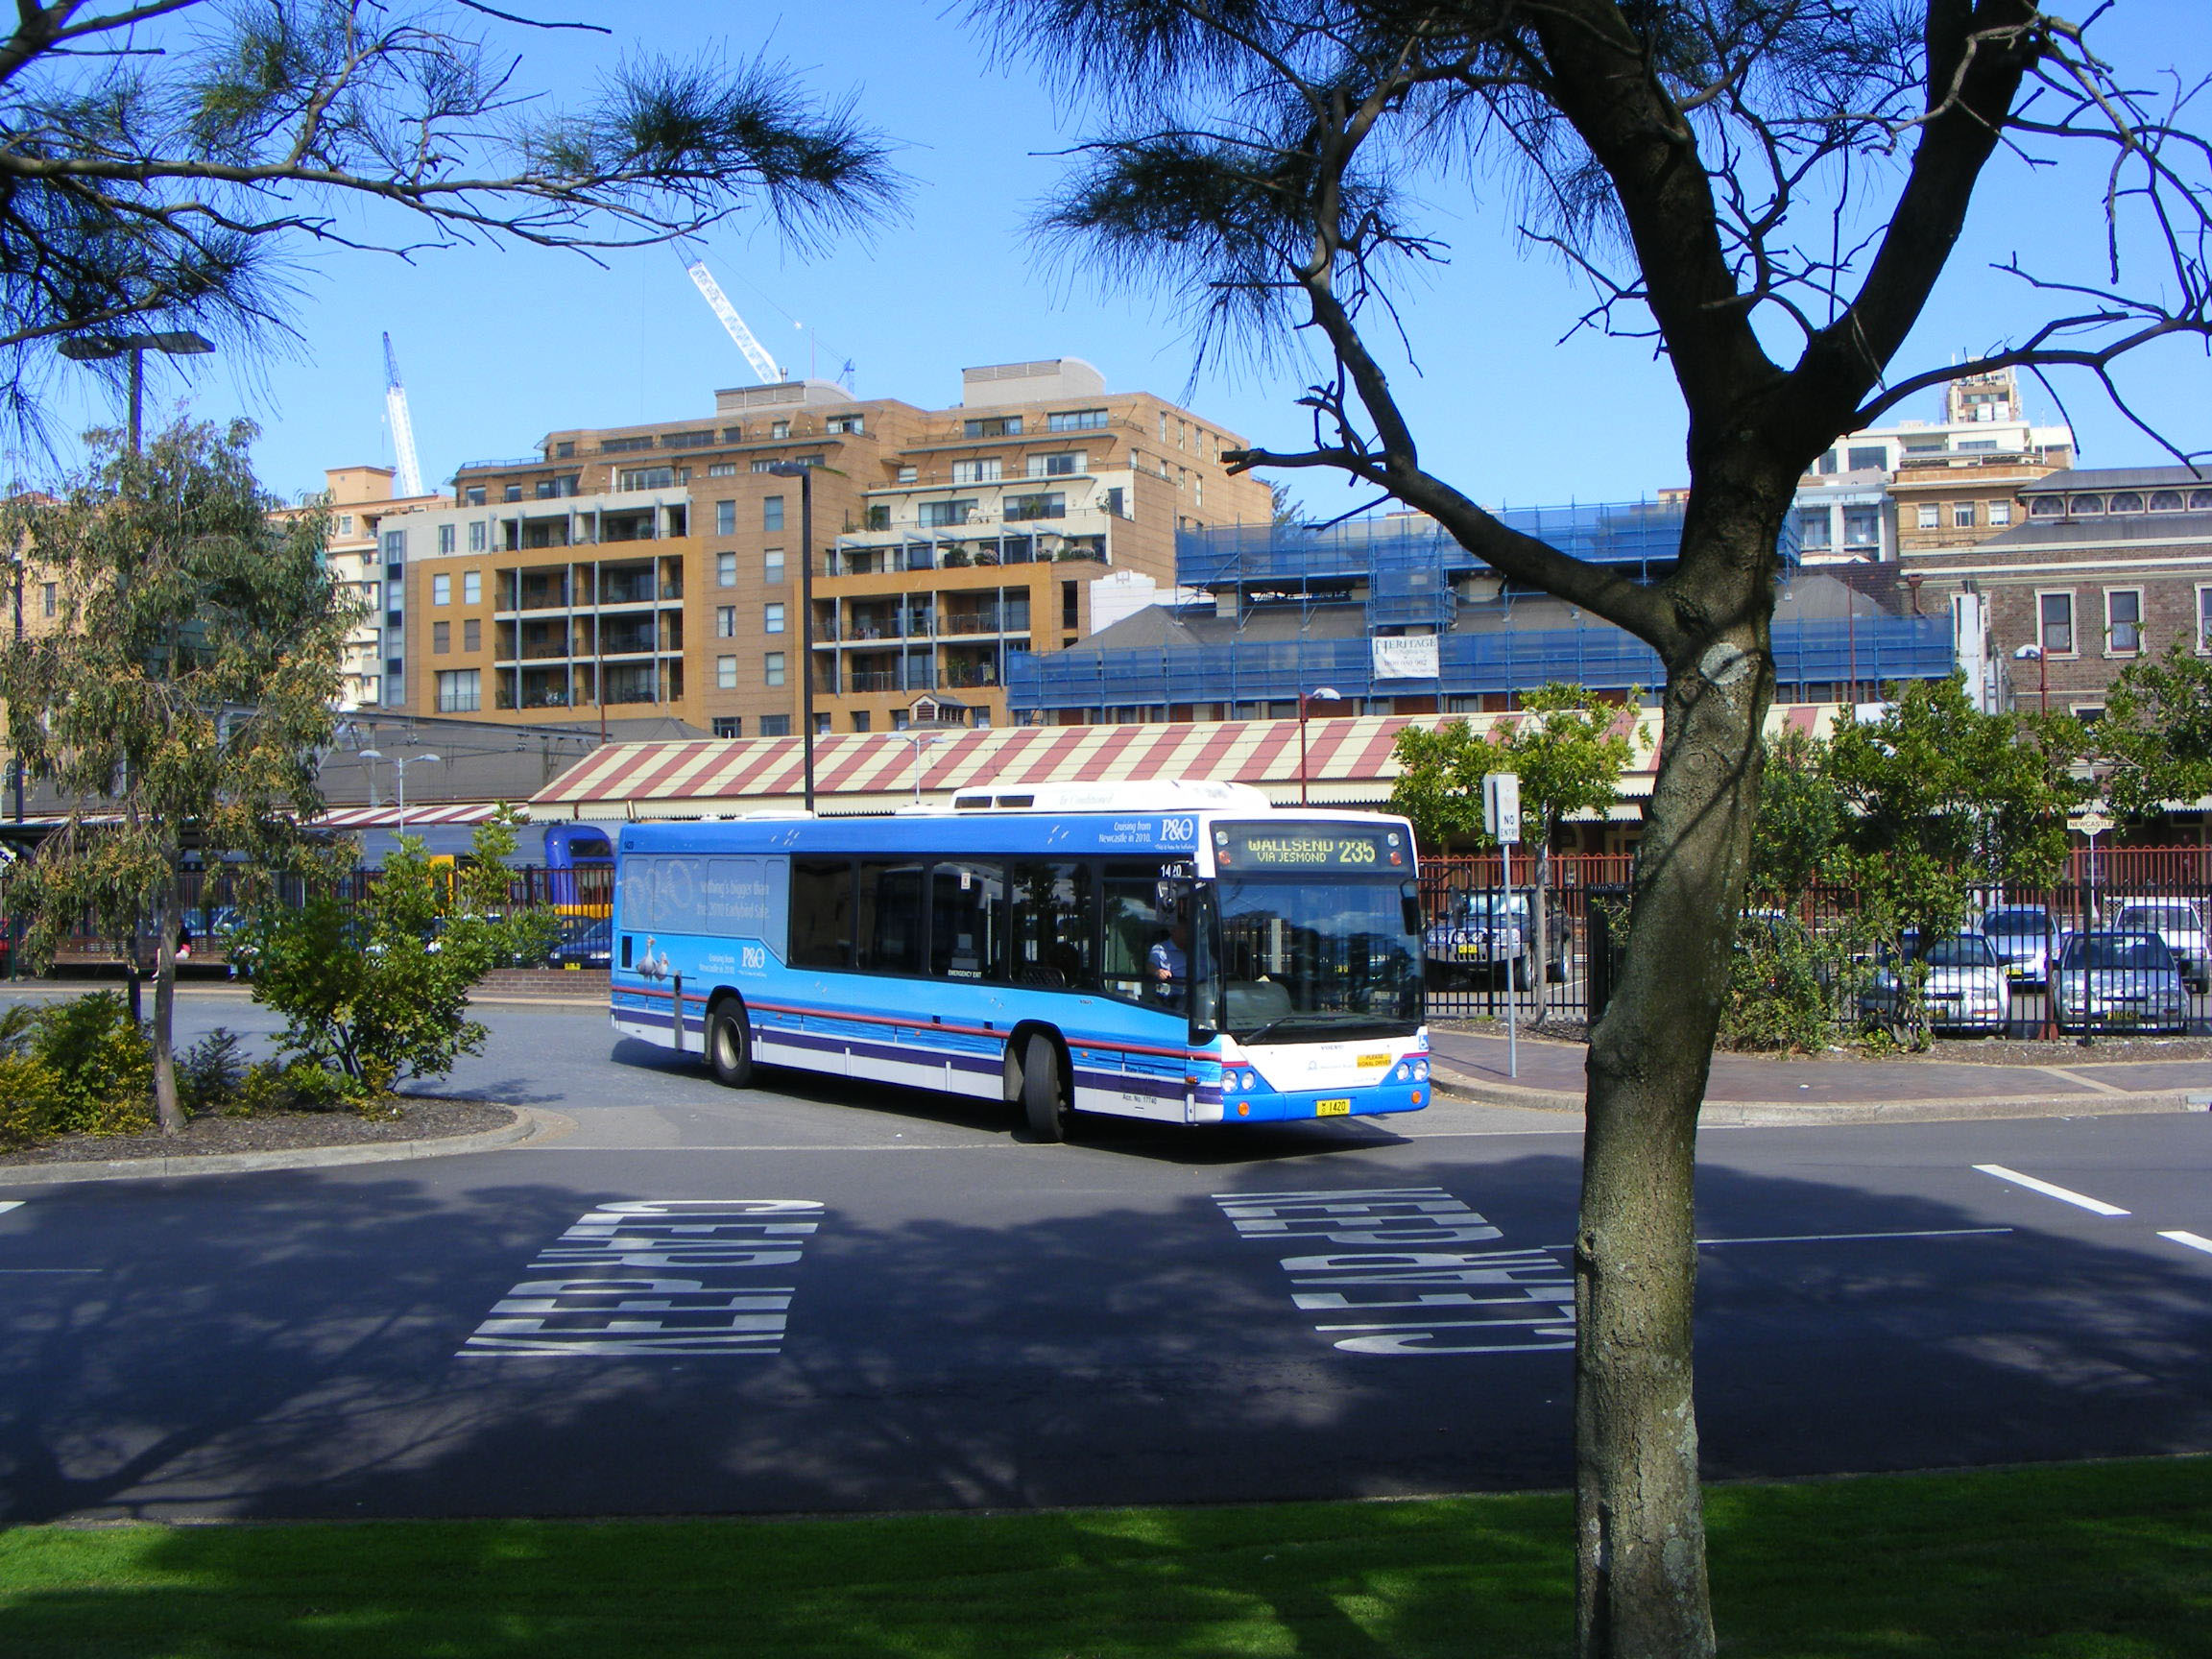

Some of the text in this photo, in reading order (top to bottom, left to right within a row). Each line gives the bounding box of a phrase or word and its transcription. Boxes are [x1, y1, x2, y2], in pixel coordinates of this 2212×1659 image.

[1375, 638, 1437, 654] HERITAGE
[1504, 815, 1514, 825] NO
[1098, 833, 1128, 843] Newcastle
[1128, 833, 1135, 842] in
[1114, 818, 1194, 842] Cruising from P&O
[1501, 829, 1517, 837] ENTRY
[1248, 838, 1334, 853] WALLSEND
[1338, 840, 1377, 863] 235
[1257, 851, 1328, 862] VIA JESMOND
[742, 948, 764, 969] P&O
[1329, 1101, 1346, 1112] 1420
[1211, 1187, 1504, 1244] KEEP
[526, 1199, 825, 1269] CLEAR
[453, 1278, 796, 1358] KEEP
